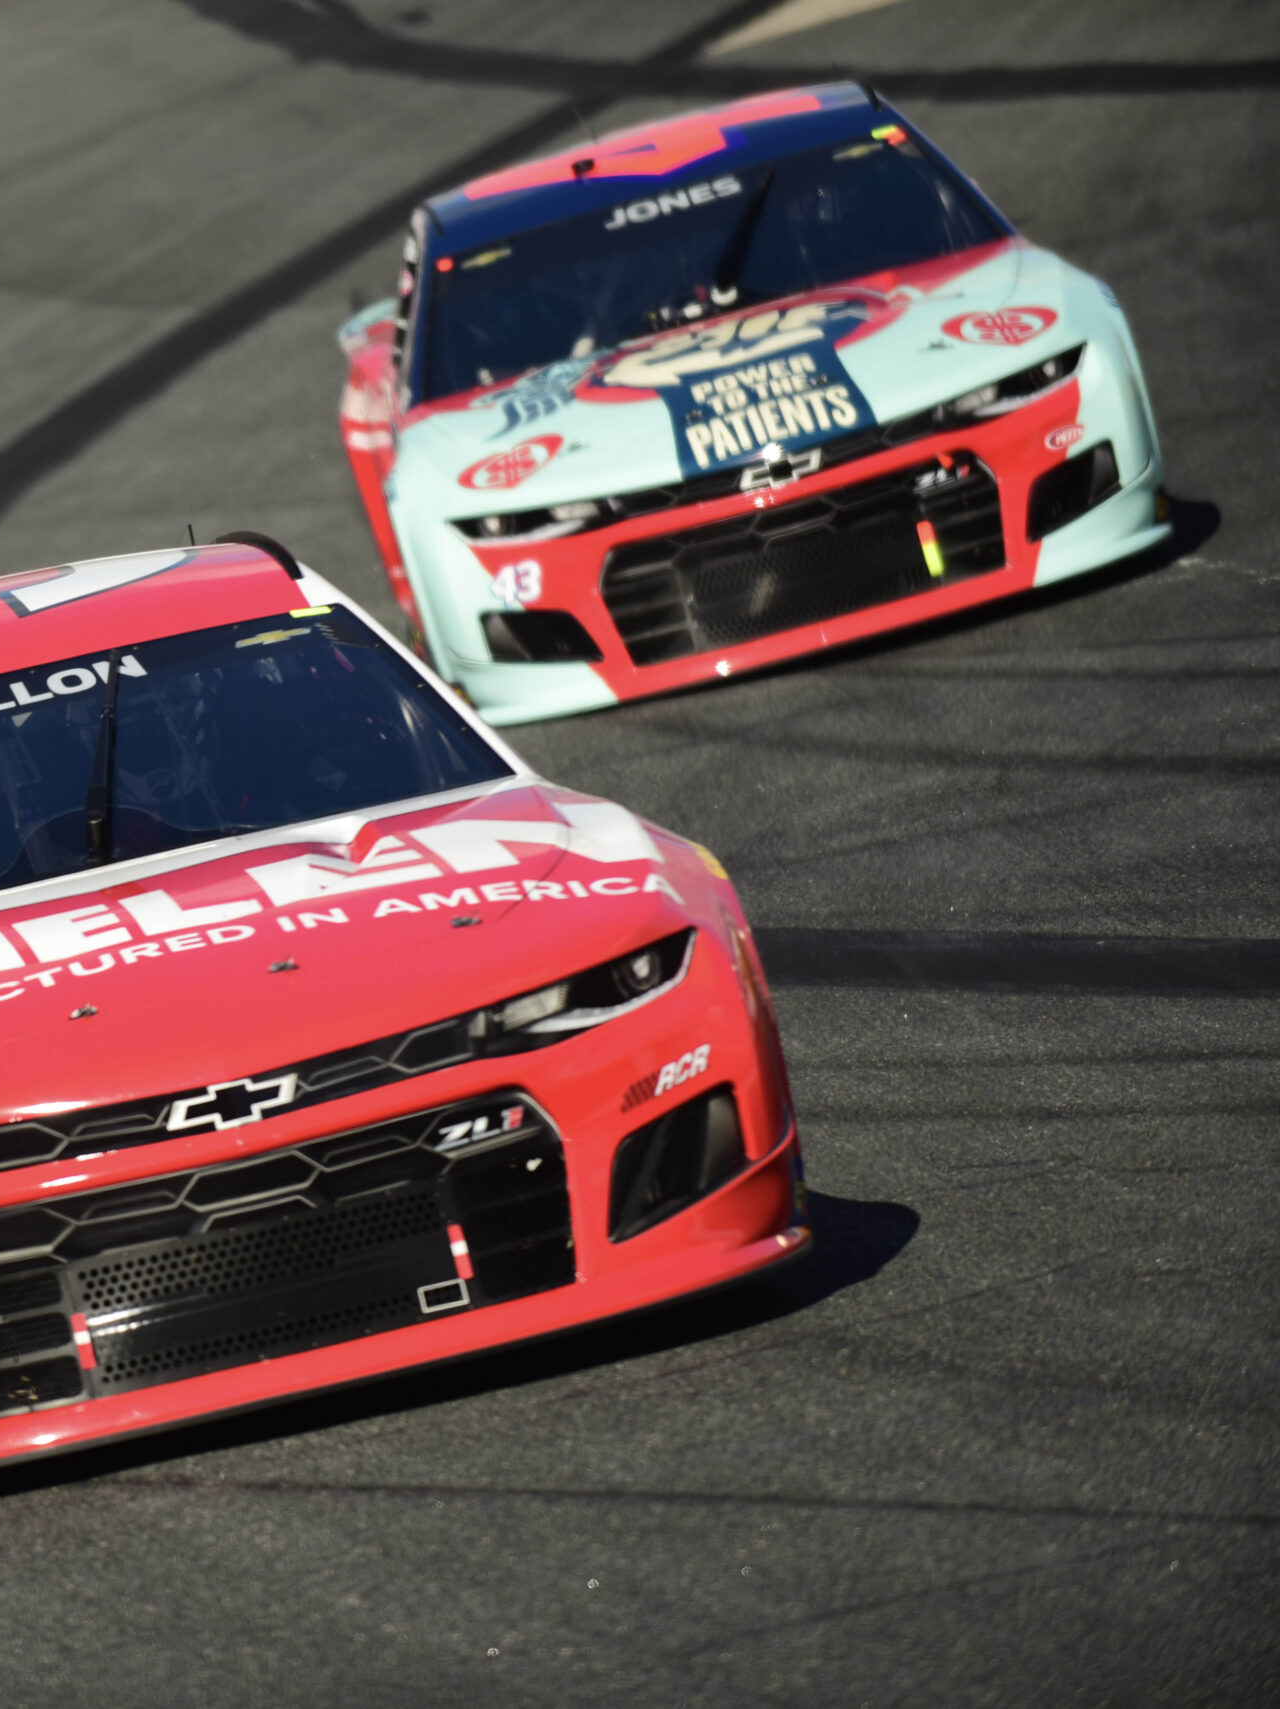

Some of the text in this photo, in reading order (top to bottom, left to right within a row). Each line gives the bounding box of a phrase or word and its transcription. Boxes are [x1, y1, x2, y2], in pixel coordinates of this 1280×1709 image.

[604, 174, 742, 231] JONES
[690, 353, 816, 405] POWER
[707, 373, 810, 417] TO THE
[685, 384, 858, 471] PATIENTS
[491, 558, 542, 610] 43
[277, 905, 350, 934] IN
[372, 873, 687, 919] AMERICA
[653, 1043, 711, 1097] RCR
[433, 1103, 525, 1153] ZL1
